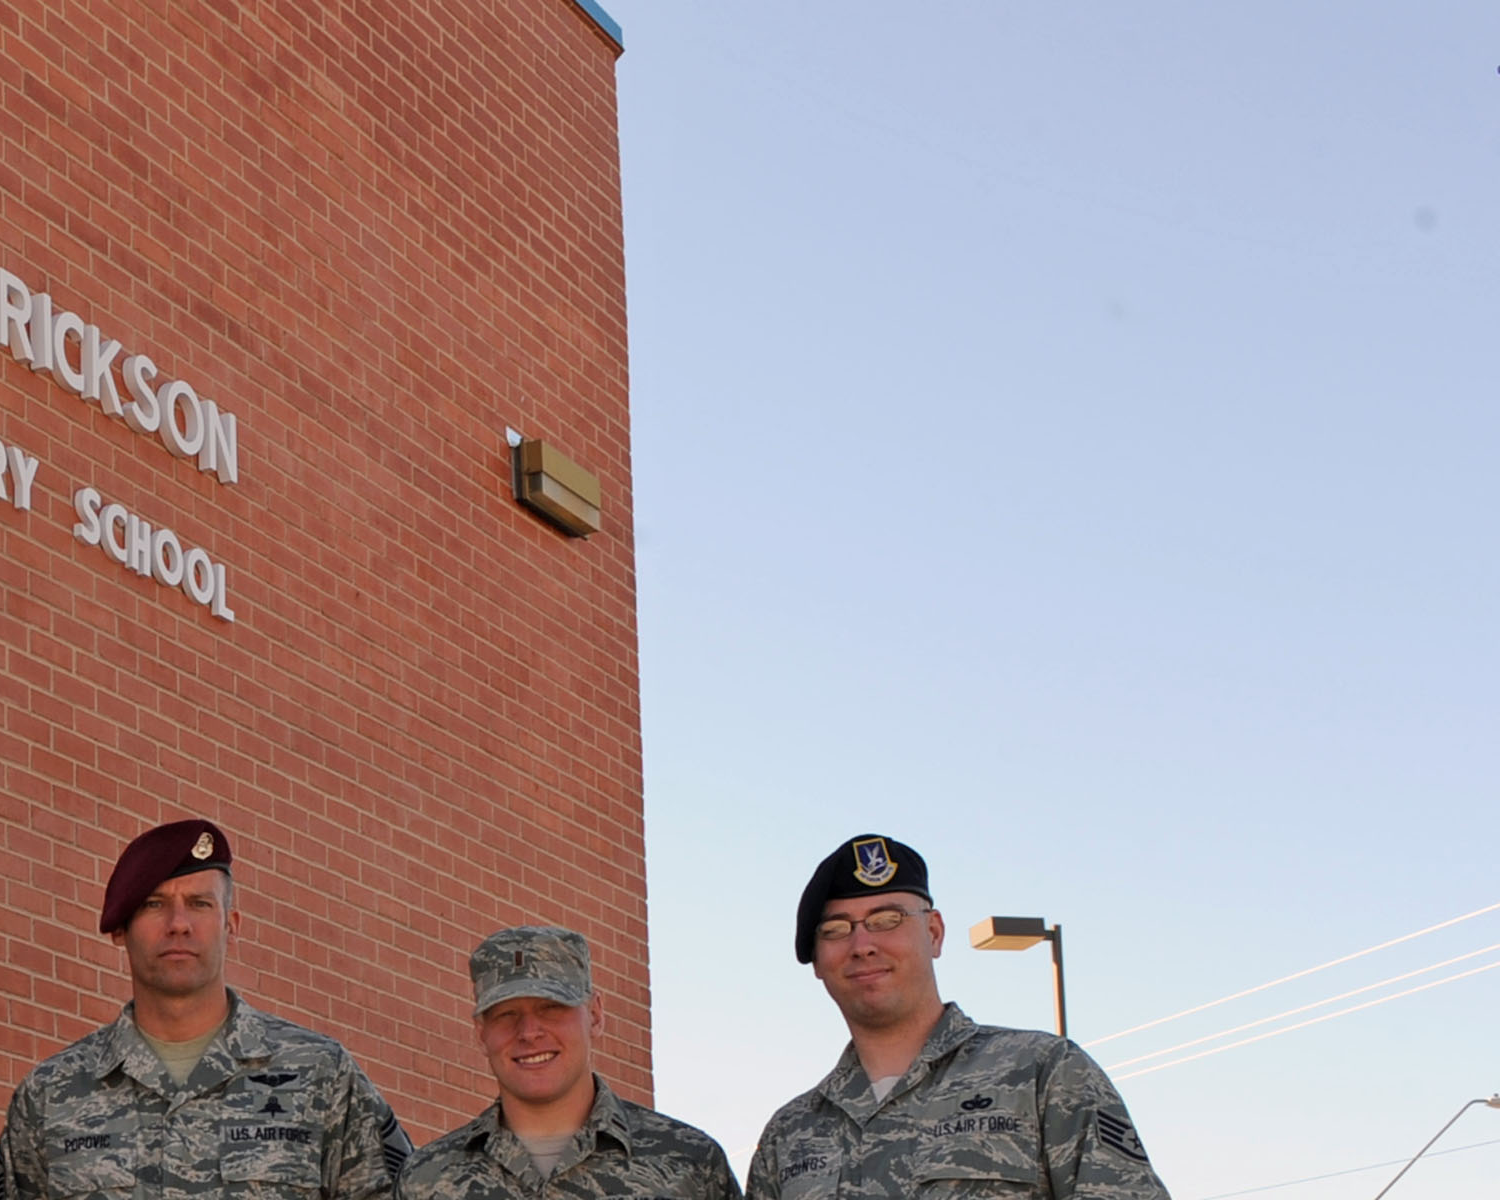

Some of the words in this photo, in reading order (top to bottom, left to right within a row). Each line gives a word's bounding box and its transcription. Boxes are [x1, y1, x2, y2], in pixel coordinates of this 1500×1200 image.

[73, 487, 235, 622] SCHOOL
[955, 1119, 976, 1133] AIR
[979, 1116, 1022, 1133] FORCE
[65, 1134, 110, 1153] POPOVIC
[255, 1127, 276, 1140] AIR
[279, 1127, 312, 1144] FORCE
